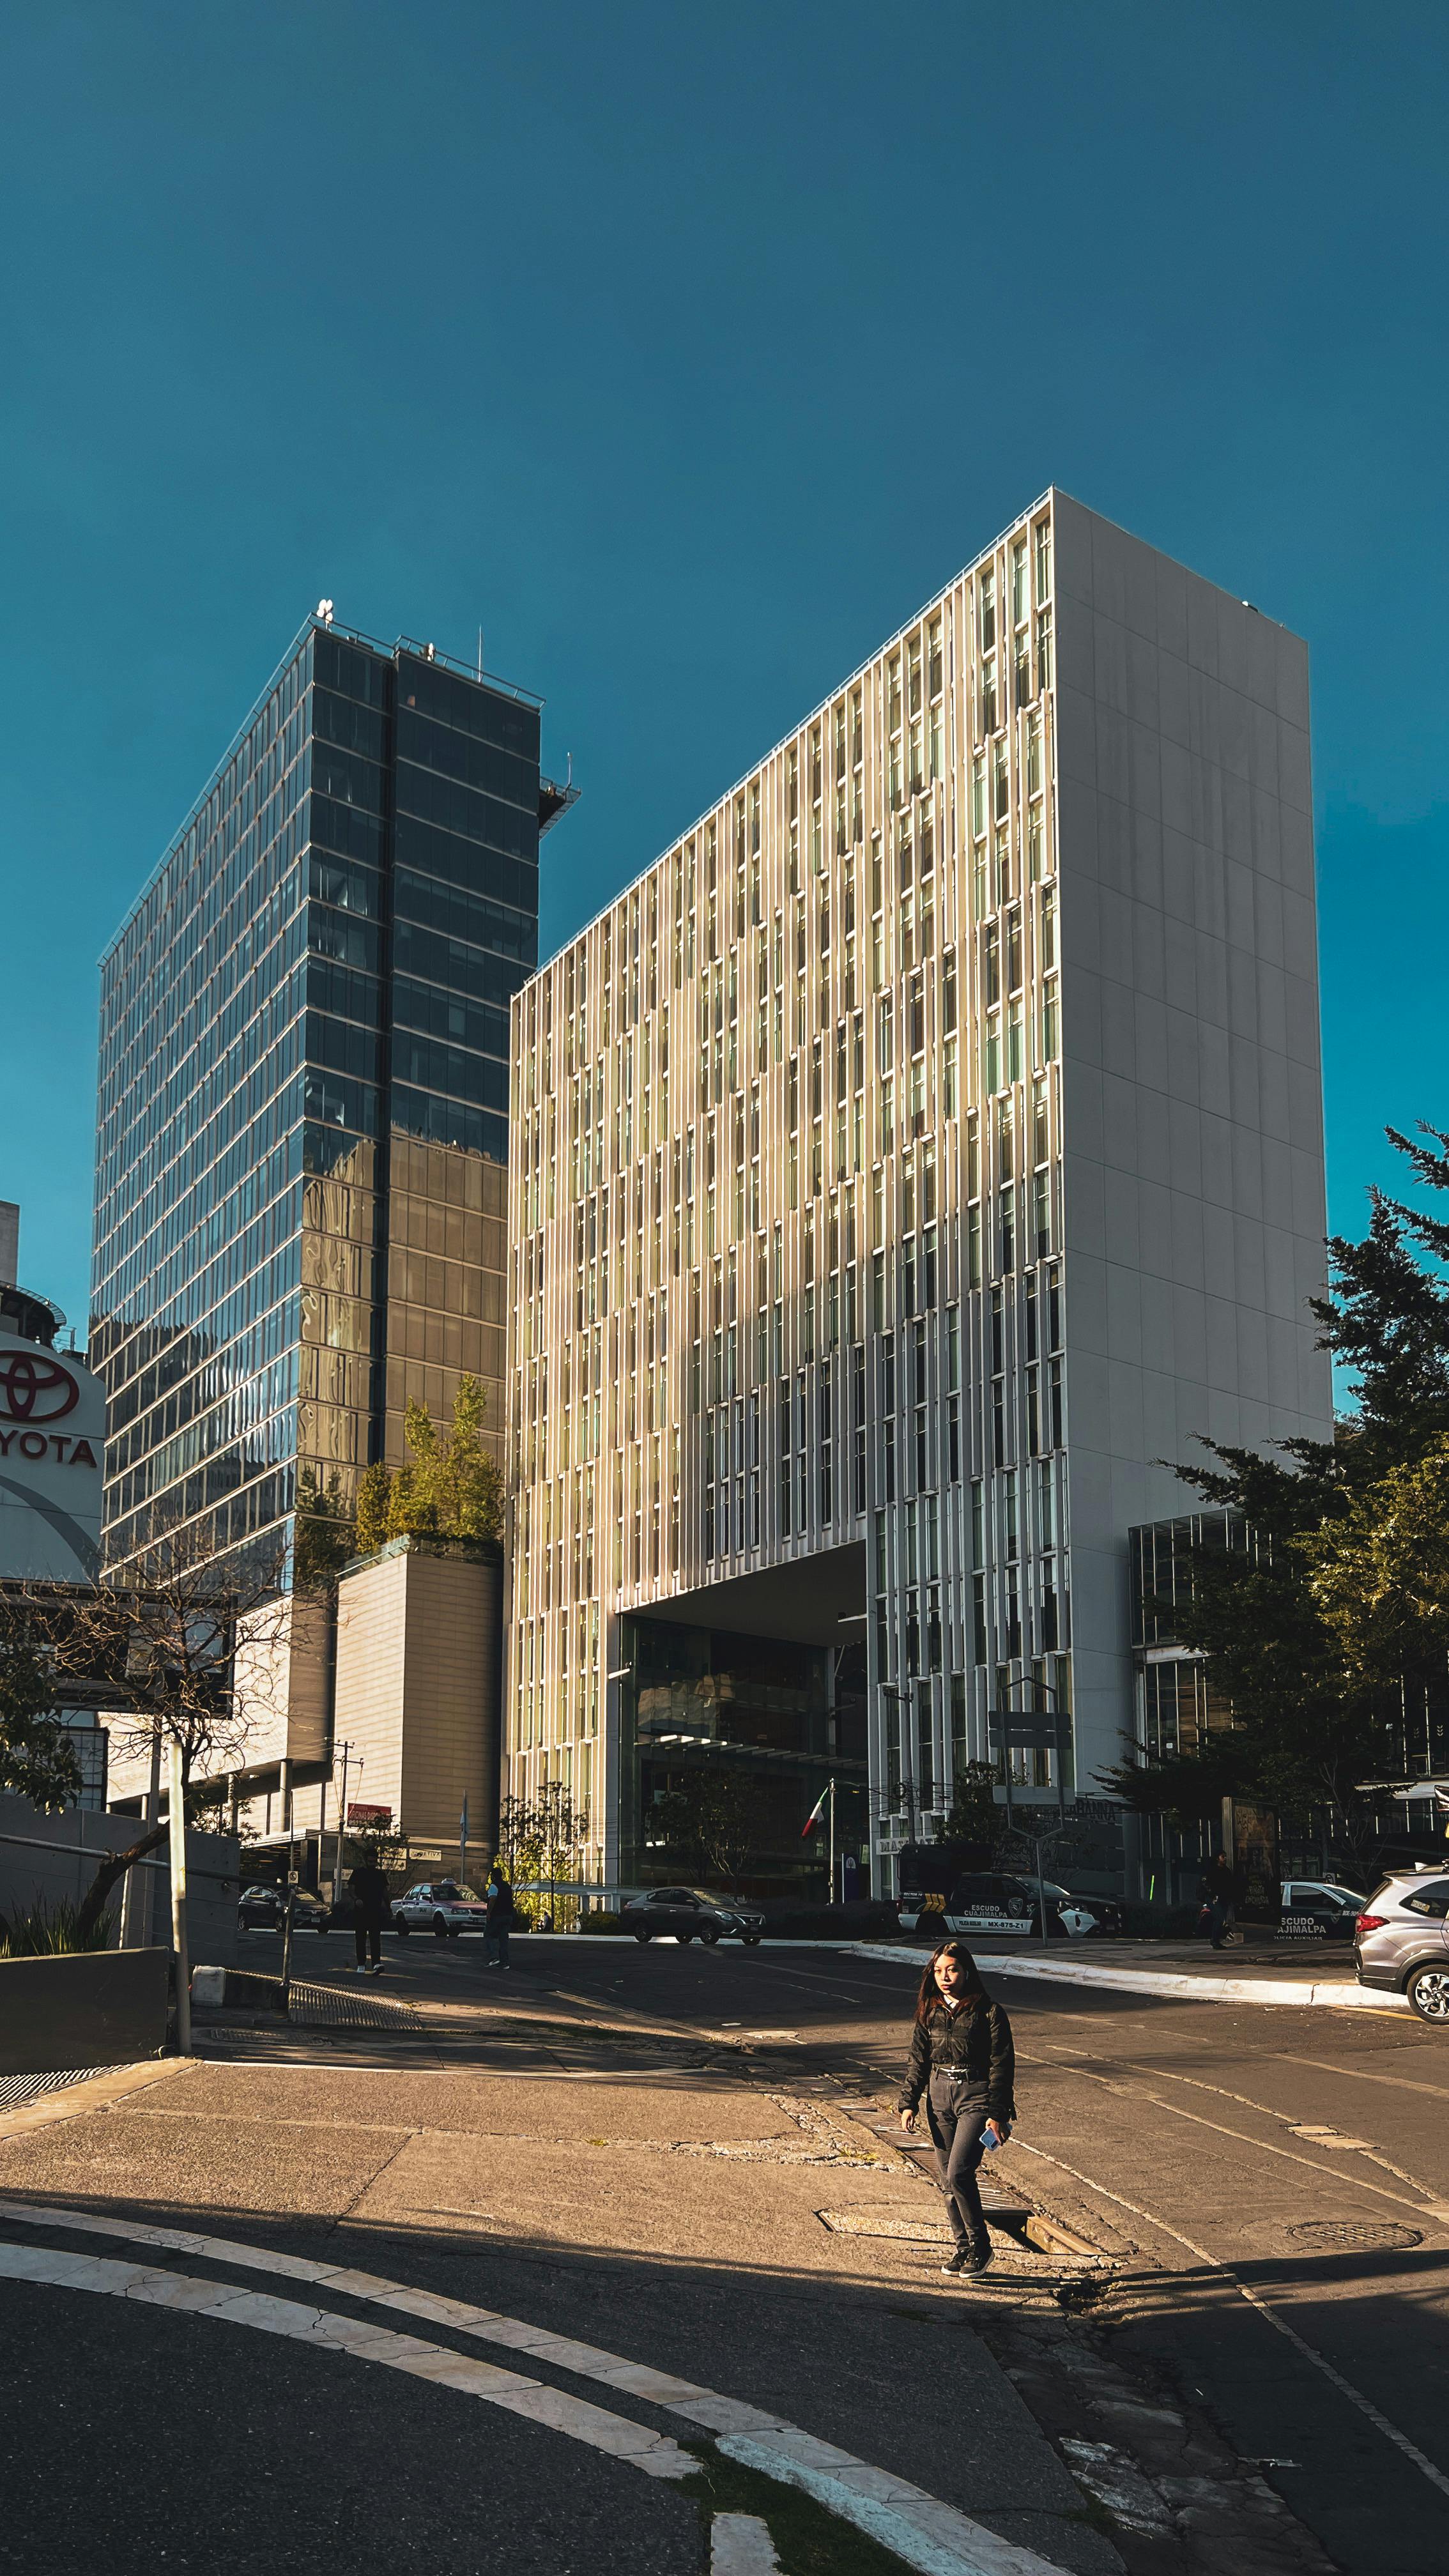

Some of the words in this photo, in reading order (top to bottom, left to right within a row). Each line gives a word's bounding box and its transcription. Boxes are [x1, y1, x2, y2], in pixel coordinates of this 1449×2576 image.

[0, 1430, 97, 1468] YOTA
[1281, 1917, 1314, 1926] SCUDO
[1277, 1925, 1327, 1933] AJIMALPA
